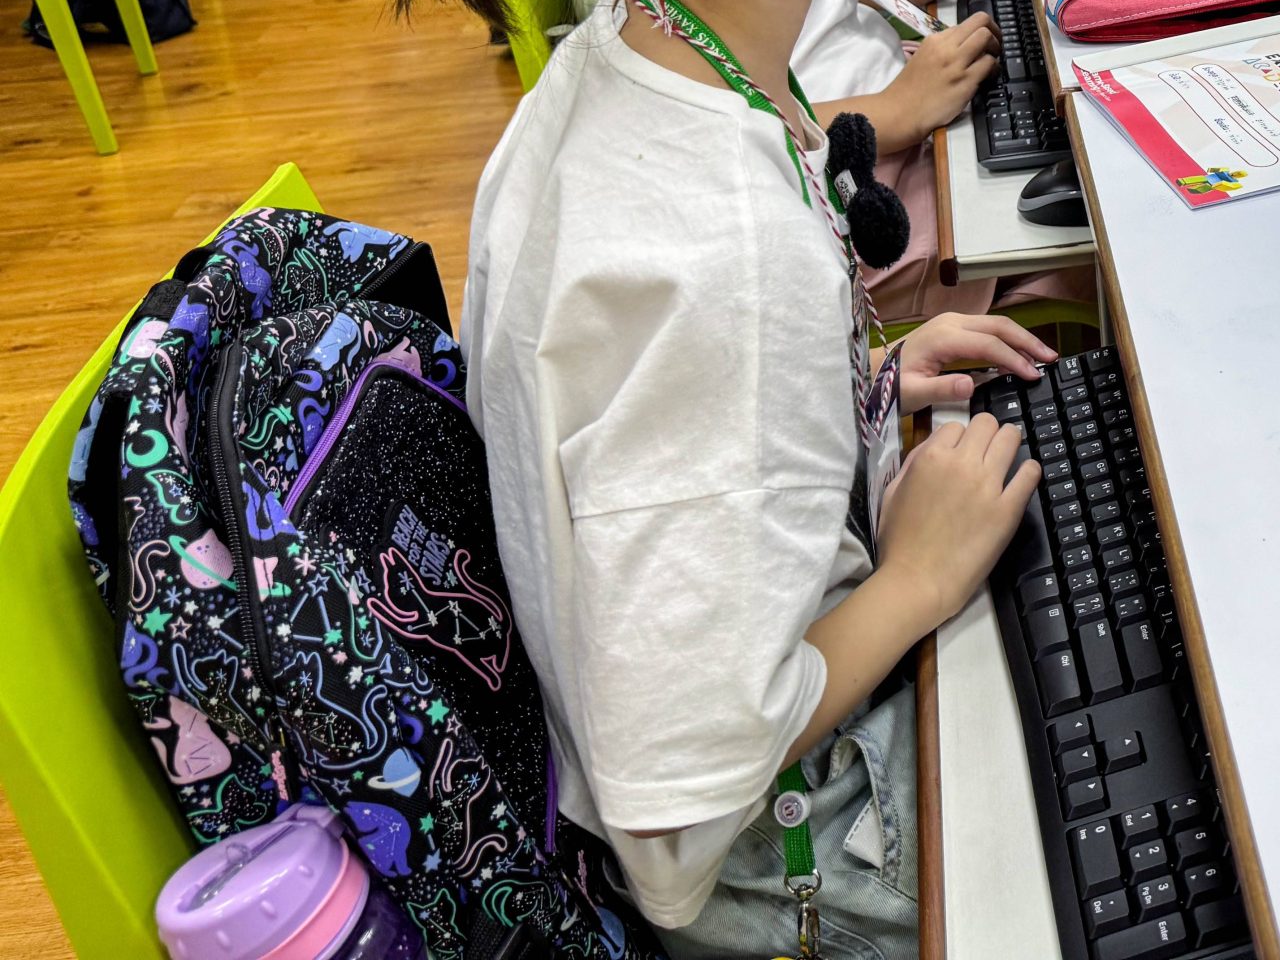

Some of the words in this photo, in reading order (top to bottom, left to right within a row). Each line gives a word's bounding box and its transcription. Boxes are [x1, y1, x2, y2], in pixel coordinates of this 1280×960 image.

[391, 504, 419, 551] REACH
[413, 521, 429, 544] THE
[408, 542, 422, 566] FOR
[1097, 623, 1106, 637] Shift
[1140, 624, 1149, 640] Enter
[1061, 655, 1070, 666] Ctrl
[1125, 814, 1133, 826] End
[1079, 829, 1087, 840] Ins
[1094, 901, 1102, 913] Del
[1158, 921, 1168, 941] Enter
